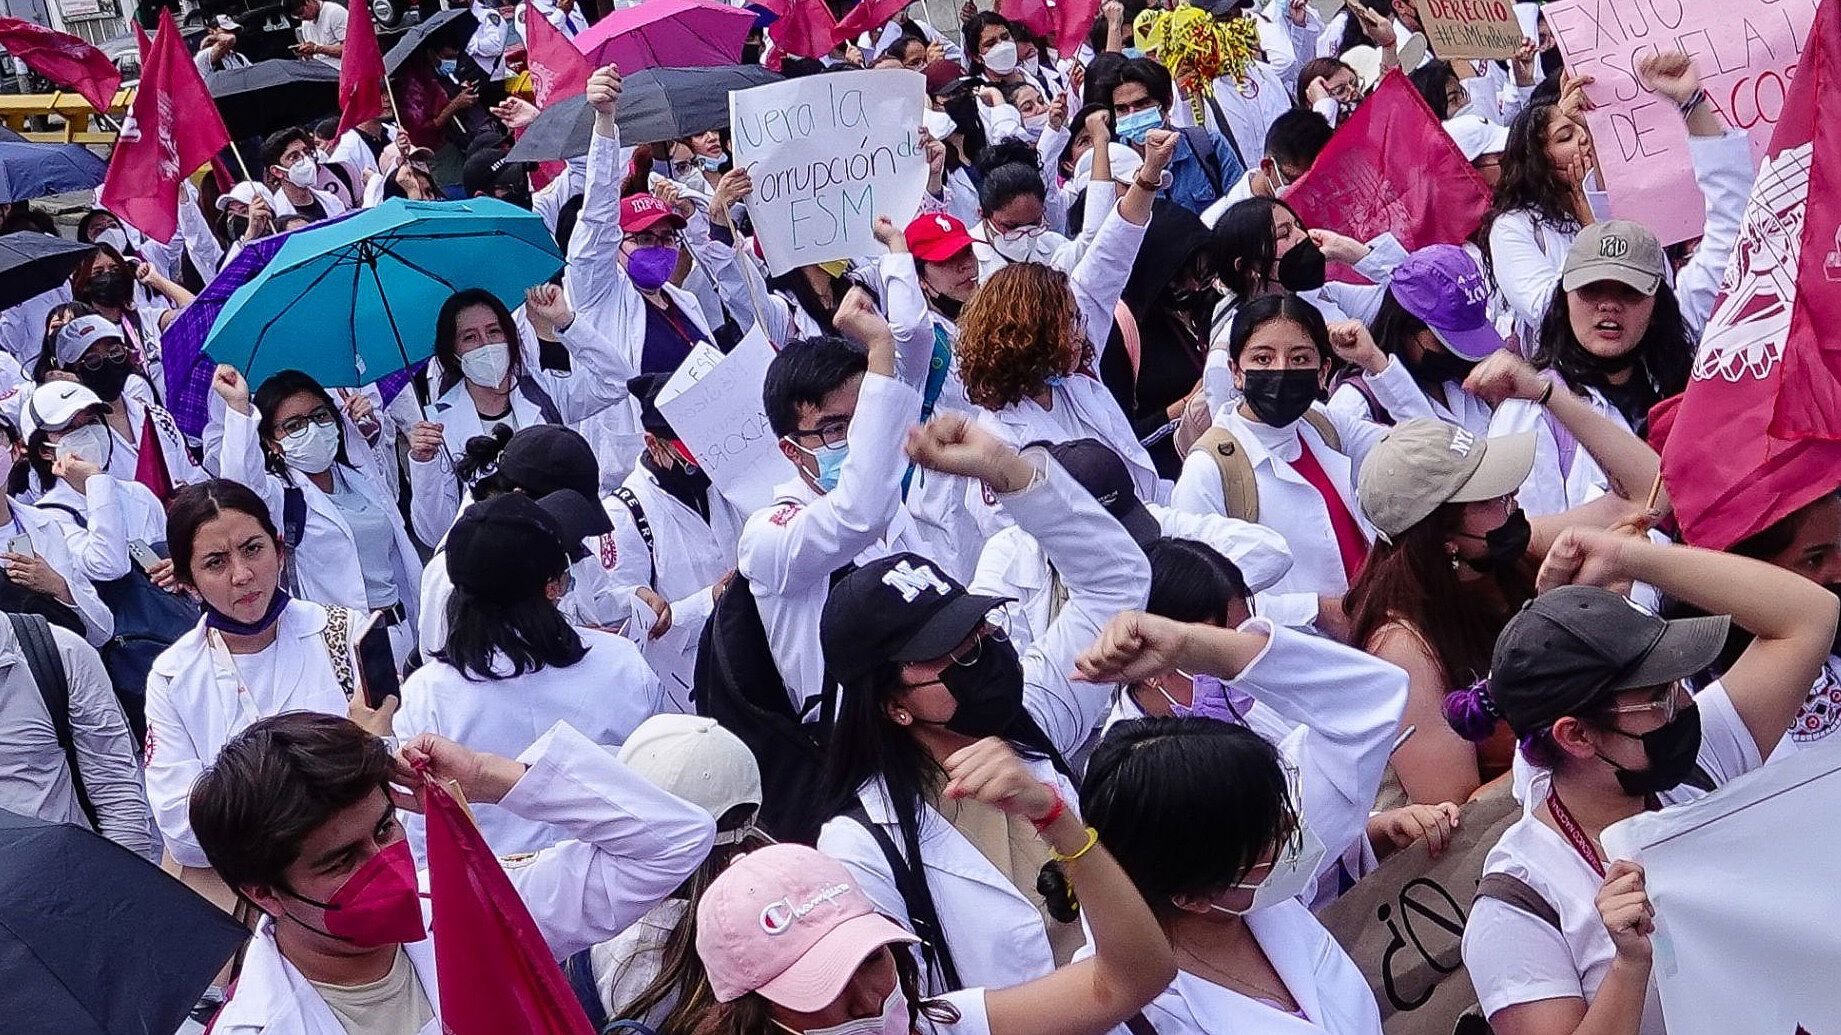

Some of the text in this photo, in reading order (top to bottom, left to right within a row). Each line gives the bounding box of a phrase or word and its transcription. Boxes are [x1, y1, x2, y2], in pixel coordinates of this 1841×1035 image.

[1549, 0, 1684, 56] EXIJO
[828, 83, 869, 128] la
[1610, 101, 1669, 162] DE
[790, 184, 874, 251] ESM
